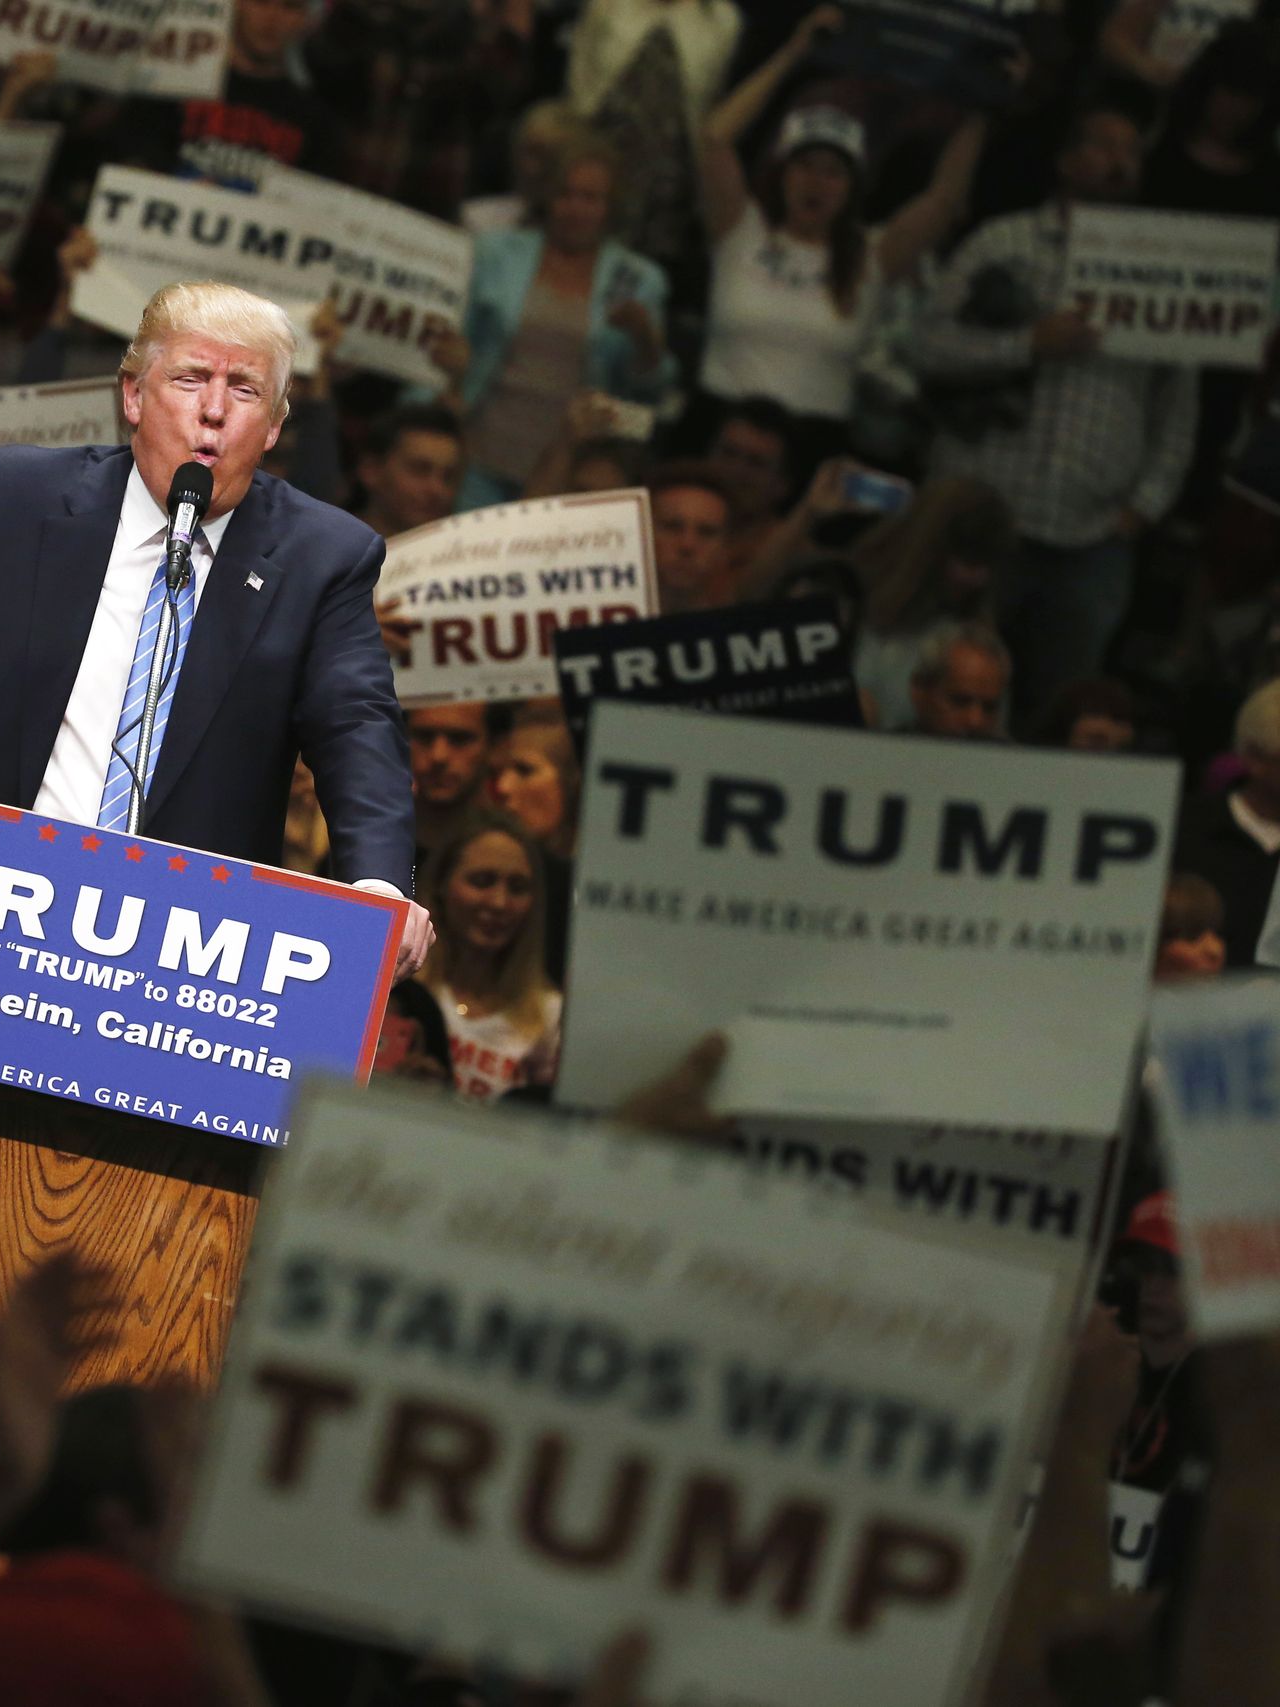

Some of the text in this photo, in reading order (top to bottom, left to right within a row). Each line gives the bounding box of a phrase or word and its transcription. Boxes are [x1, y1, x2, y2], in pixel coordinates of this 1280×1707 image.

[102, 190, 334, 270] TRUMP
[1073, 290, 1261, 337] TRUMP
[538, 564, 638, 594] WITH
[559, 620, 843, 699] TRUMP
[596, 761, 1160, 884] TRUMP
[584, 880, 684, 924] MAKE
[694, 894, 872, 944] AMERICA
[880, 908, 1004, 952] GREAT
[144, 979, 170, 1003] to
[175, 983, 280, 1029] 88022
[96, 1009, 294, 1081] California
[93, 1086, 184, 1120] GREAT
[191, 1110, 293, 1147] AGAIN!
[893, 1155, 1083, 1239] WITH
[271, 1254, 1010, 1504] STANDS WITH
[249, 1362, 968, 1635] TRUMP
